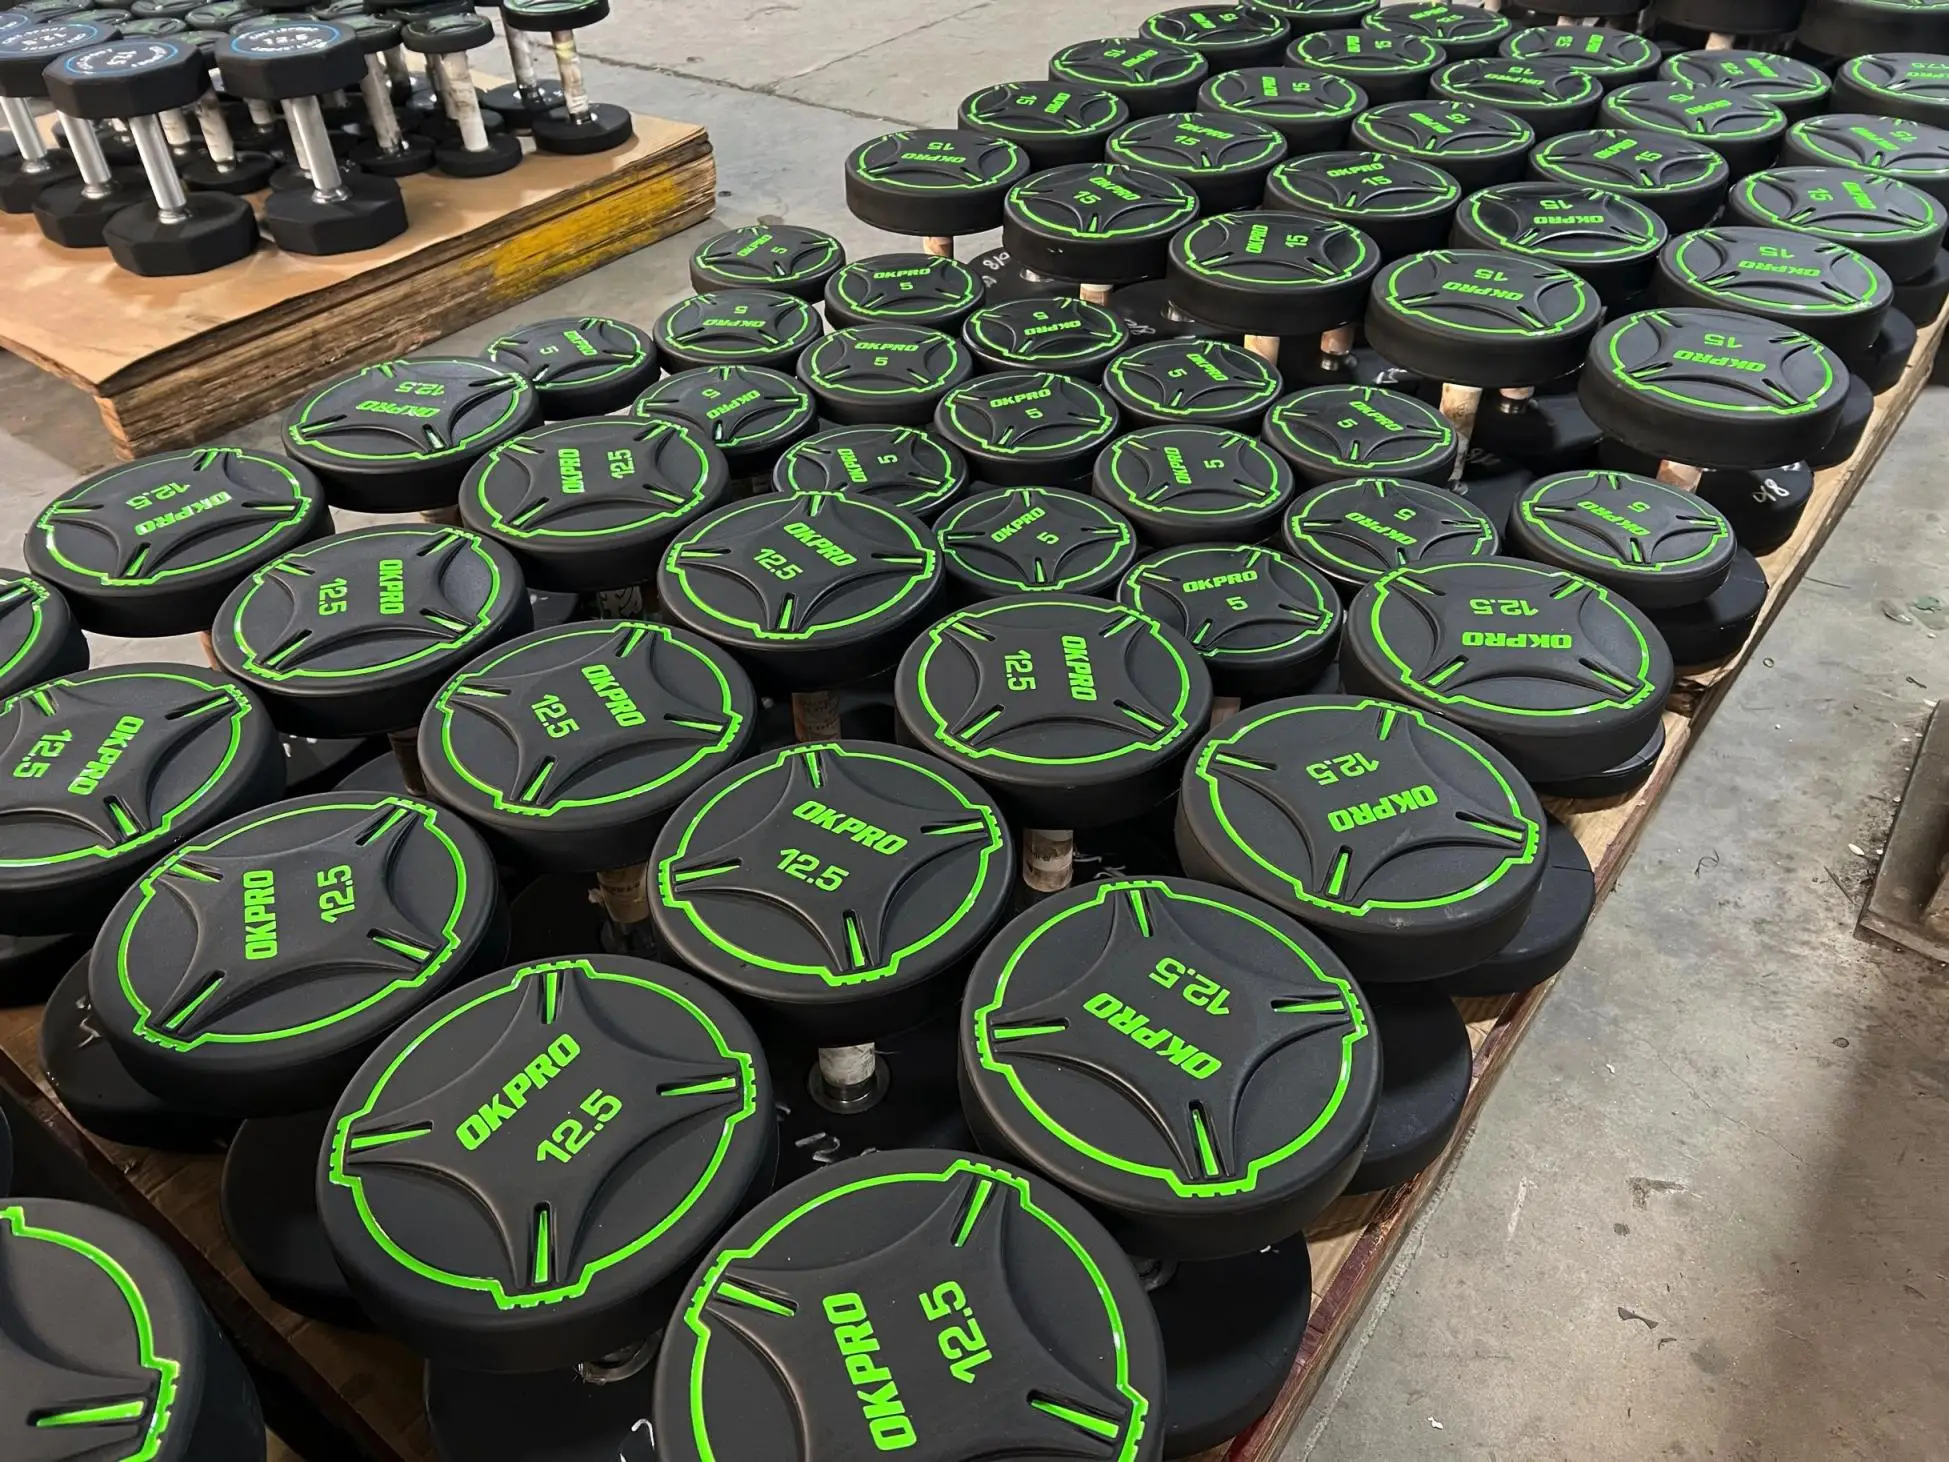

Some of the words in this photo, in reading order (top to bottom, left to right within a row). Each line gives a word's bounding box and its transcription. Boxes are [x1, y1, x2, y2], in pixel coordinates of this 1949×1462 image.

[1177, 123, 1232, 140] OKPRO
[1328, 161, 1383, 176] OKPRO
[1364, 175, 1392, 186] 15
[1075, 190, 1101, 204] 15
[1091, 176, 1139, 200] OKPRO
[1540, 200, 1574, 211] 15
[1535, 215, 1603, 226] OKPRO
[1244, 224, 1268, 255] OKPRO
[1285, 235, 1309, 247] 15
[1758, 247, 1796, 258] 15
[875, 268, 929, 280] OKPRO
[1473, 267, 1508, 281] 15
[1738, 260, 1821, 278] OKPRO
[898, 281, 913, 290] 5
[1443, 281, 1525, 301] OKPRO
[704, 319, 764, 328] OKPRO
[1024, 321, 1080, 335] OKPRO
[1034, 312, 1050, 321] 5
[855, 341, 919, 351] OKPRO
[1703, 333, 1744, 349] 15
[872, 355, 889, 367] 5
[1168, 367, 1184, 376] 5
[1189, 353, 1228, 381] OKPRO
[1673, 349, 1766, 372] OKPRO
[703, 388, 719, 398] 5
[990, 388, 1052, 408] OKPRO
[356, 400, 441, 419] OKPRO
[707, 391, 760, 420] OKPRO
[1025, 409, 1044, 420] 5
[1349, 400, 1403, 431] OKPRO
[1337, 419, 1357, 428] 5
[559, 447, 583, 494] OKPRO
[608, 448, 633, 479] 12.5
[837, 447, 868, 482] OKPRO
[877, 454, 897, 464] 5
[1164, 448, 1191, 487] OKPRO
[1204, 459, 1223, 469] 5
[126, 482, 191, 509] 12.5
[1630, 502, 1648, 513] 5
[134, 492, 232, 537] OKPRO
[992, 507, 1045, 543] OKPRO
[1396, 509, 1416, 522] 5
[1578, 501, 1649, 537] OKPRO
[1037, 532, 1060, 543] 5
[1347, 509, 1415, 546] OKPRO
[784, 521, 856, 567] OKPRO
[754, 547, 800, 582] 12.5
[378, 559, 405, 616] OKPRO
[1182, 570, 1260, 594] OKPRO
[316, 576, 347, 617] 12.5
[1227, 597, 1248, 611] 5
[1469, 598, 1536, 617] 12.5
[1461, 630, 1573, 651] OKPRO
[1004, 650, 1036, 692] 12.5
[1061, 635, 1096, 702] OKPRO
[580, 664, 646, 728] OKPRO
[532, 693, 580, 739] 12.5
[12, 729, 72, 779] 12.5
[68, 715, 144, 798] OKPRO
[1306, 752, 1380, 785] 12.5
[1328, 784, 1440, 832] OKPRO
[792, 799, 909, 856] OKPRO
[778, 848, 846, 892] 12.5
[315, 865, 357, 925] 12.5
[241, 869, 278, 961] OKPRO
[1150, 956, 1231, 1016] 12.5
[1083, 992, 1224, 1080] OKPRO
[455, 1032, 583, 1152] OKPRO
[536, 1088, 624, 1163] 12.5
[918, 1280, 993, 1386] 12.5
[821, 1292, 919, 1452] OKPRO
